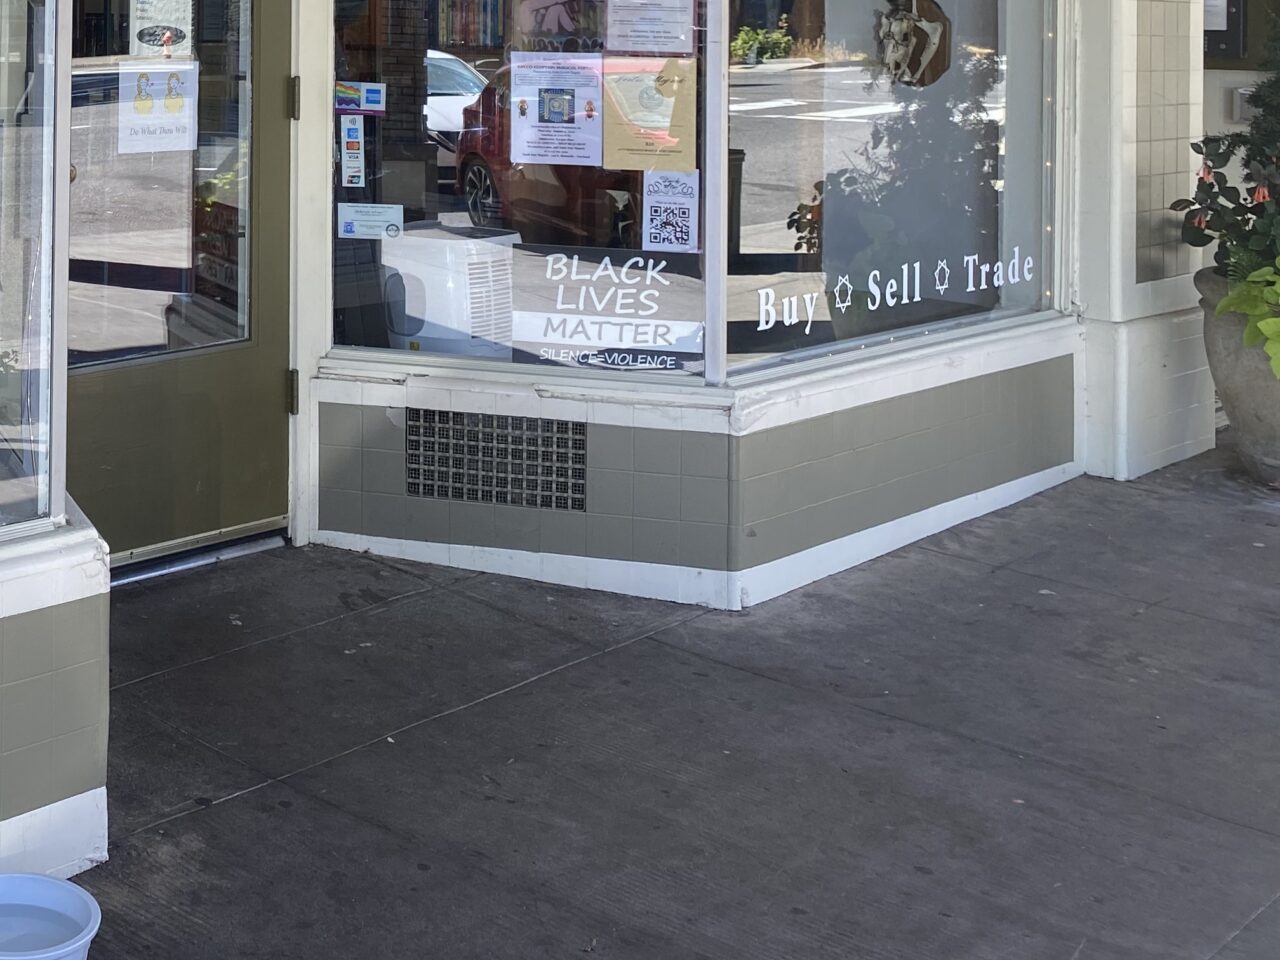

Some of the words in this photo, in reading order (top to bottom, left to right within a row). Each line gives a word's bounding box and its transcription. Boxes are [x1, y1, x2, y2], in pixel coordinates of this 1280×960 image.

[545, 253, 670, 286] BLACK
[556, 284, 660, 316] LIVES
[756, 286, 819, 335] Buy
[866, 261, 922, 311] Sell
[964, 245, 1034, 292] Trade
[543, 317, 673, 346] MATTER
[539, 347, 676, 369] SILENCE=VIOLENCE
